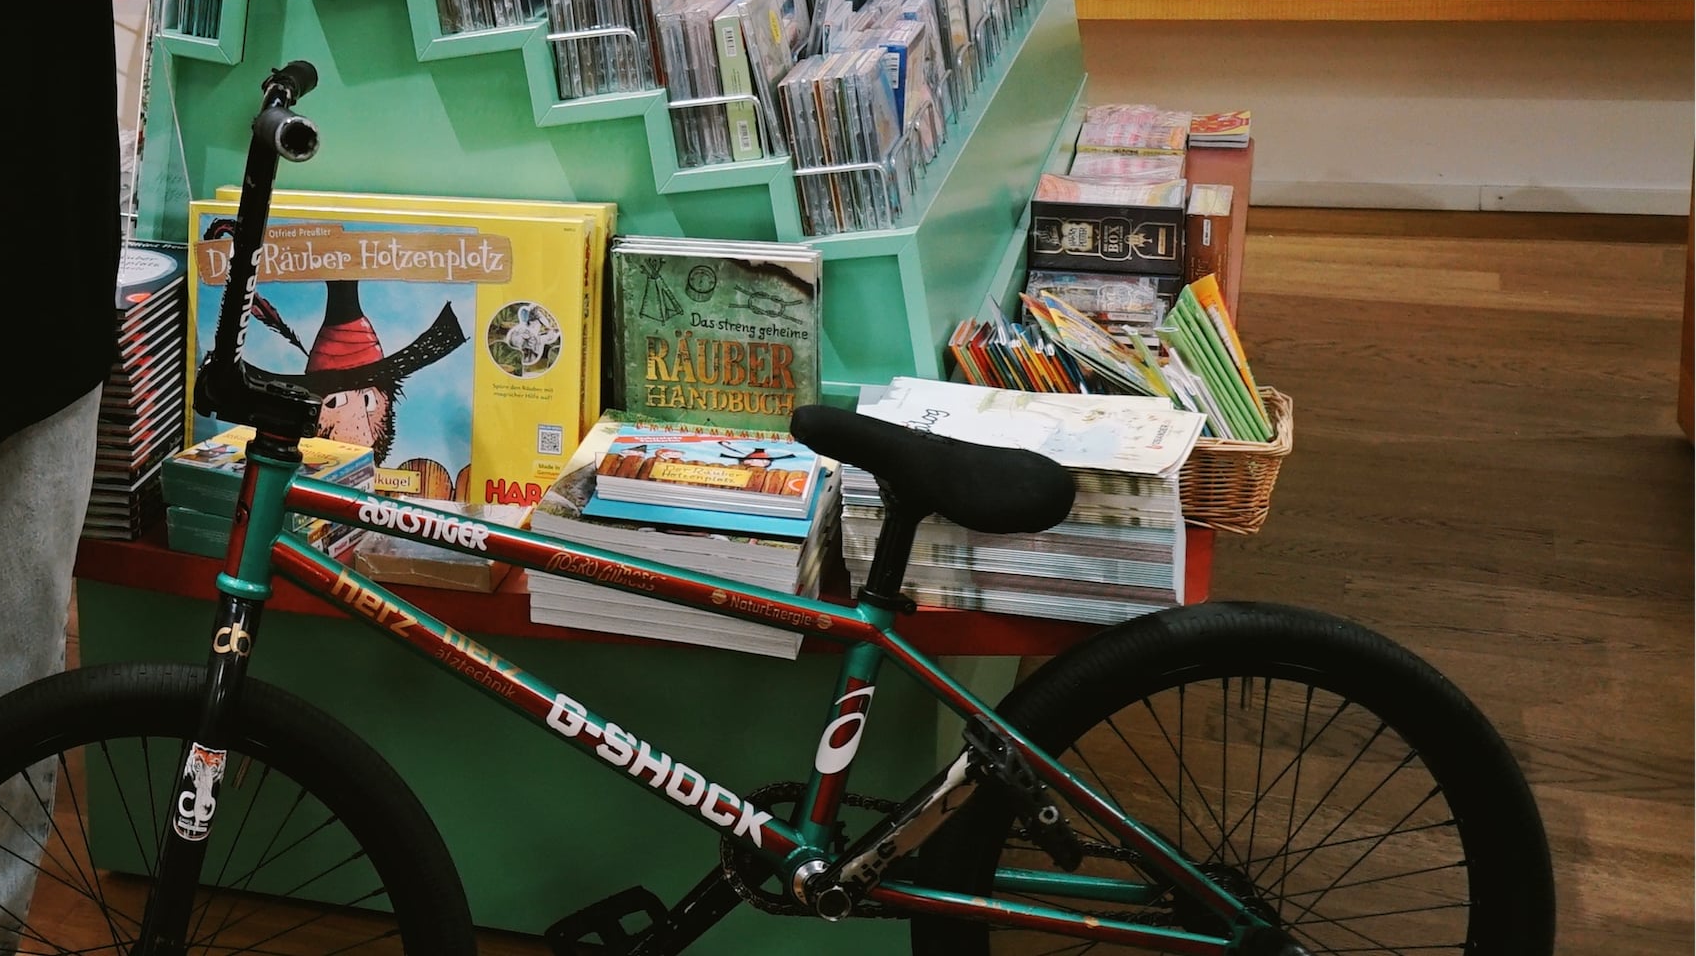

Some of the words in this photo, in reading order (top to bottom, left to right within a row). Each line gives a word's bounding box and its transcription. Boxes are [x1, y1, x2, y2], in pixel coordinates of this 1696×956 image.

[268, 227, 297, 239] Otfried
[265, 243, 351, 275] Räuber
[360, 239, 504, 280] Hotzenplotz
[690, 312, 715, 328] Das
[718, 318, 756, 339] streng
[758, 323, 809, 342] geheime
[645, 330, 795, 390] RÄUBER
[645, 384, 795, 417] HANDBUCH
[330, 568, 419, 637] herz
[730, 592, 813, 626] NaturEnergie
[546, 692, 774, 849] G-SHOCK
